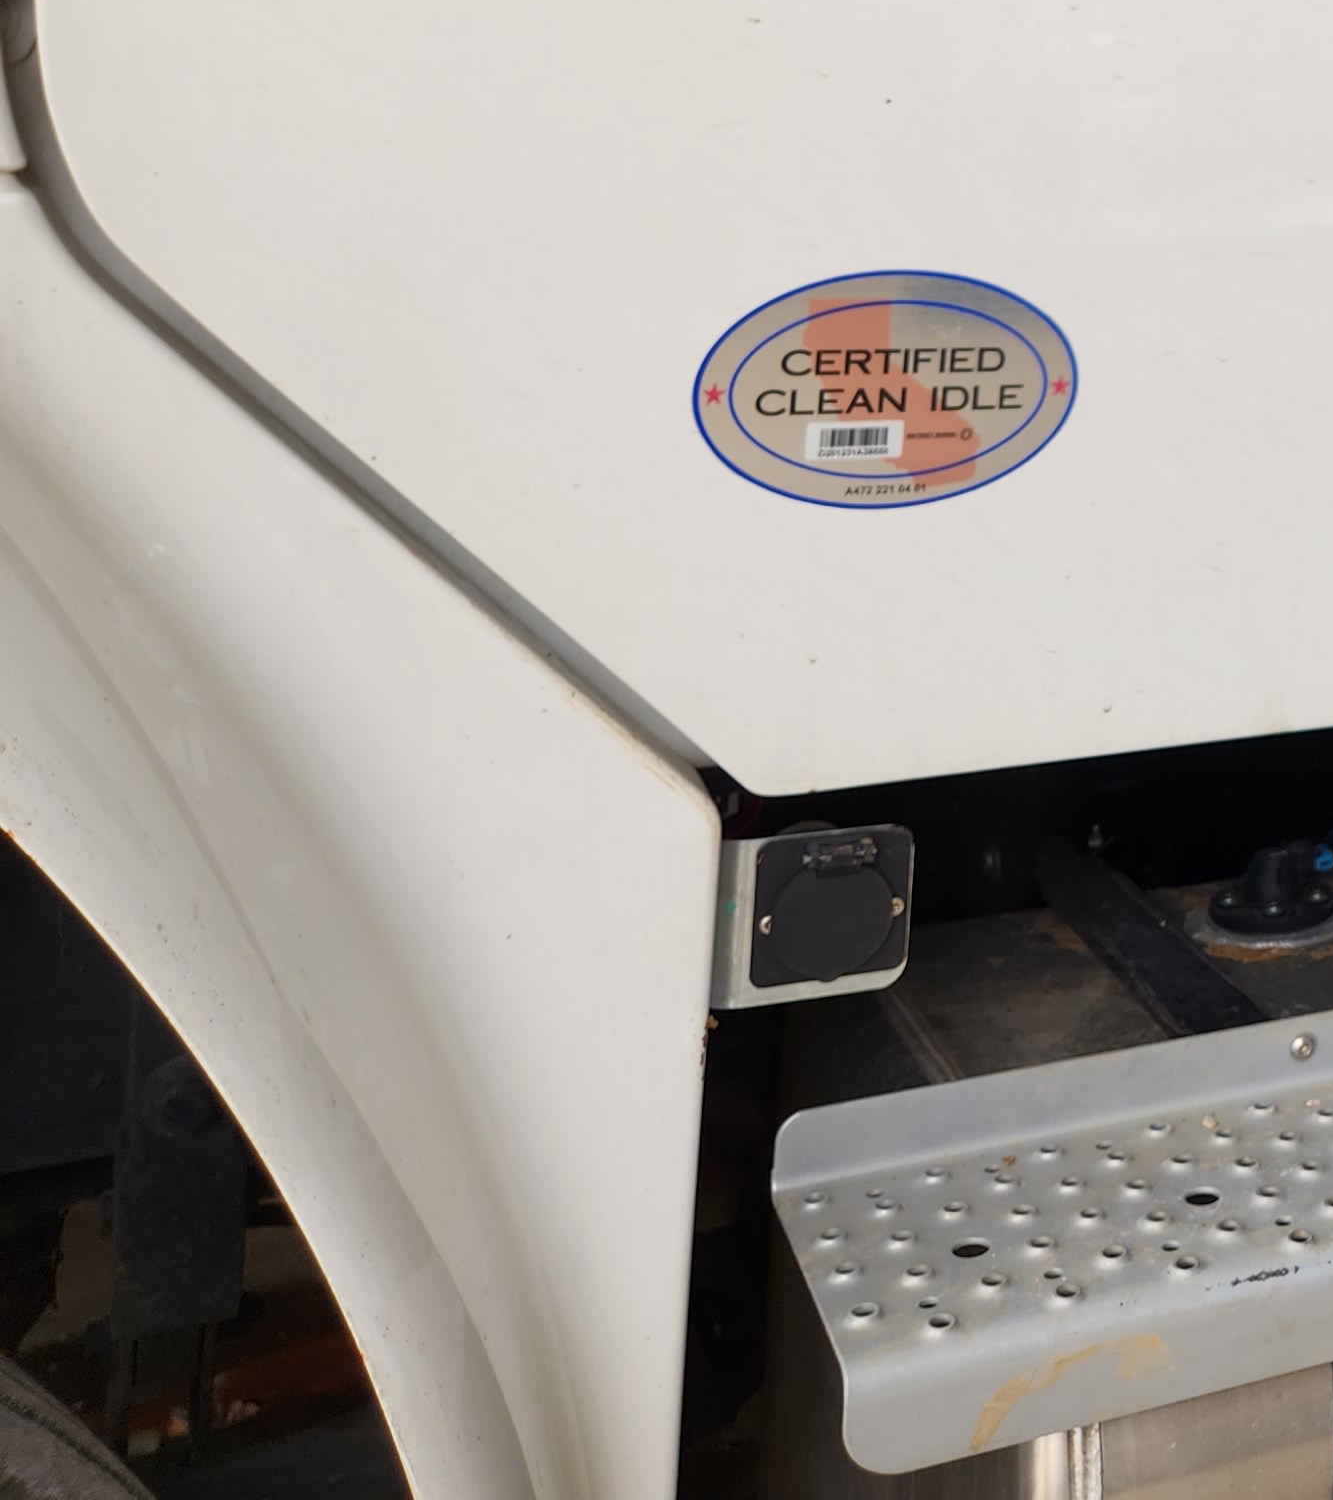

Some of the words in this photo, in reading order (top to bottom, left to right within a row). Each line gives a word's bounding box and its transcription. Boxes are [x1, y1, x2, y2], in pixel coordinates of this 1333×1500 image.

[780, 346, 1006, 377] CERTIFIED
[755, 386, 907, 417] CLEAN
[930, 383, 1024, 412] IDLE
